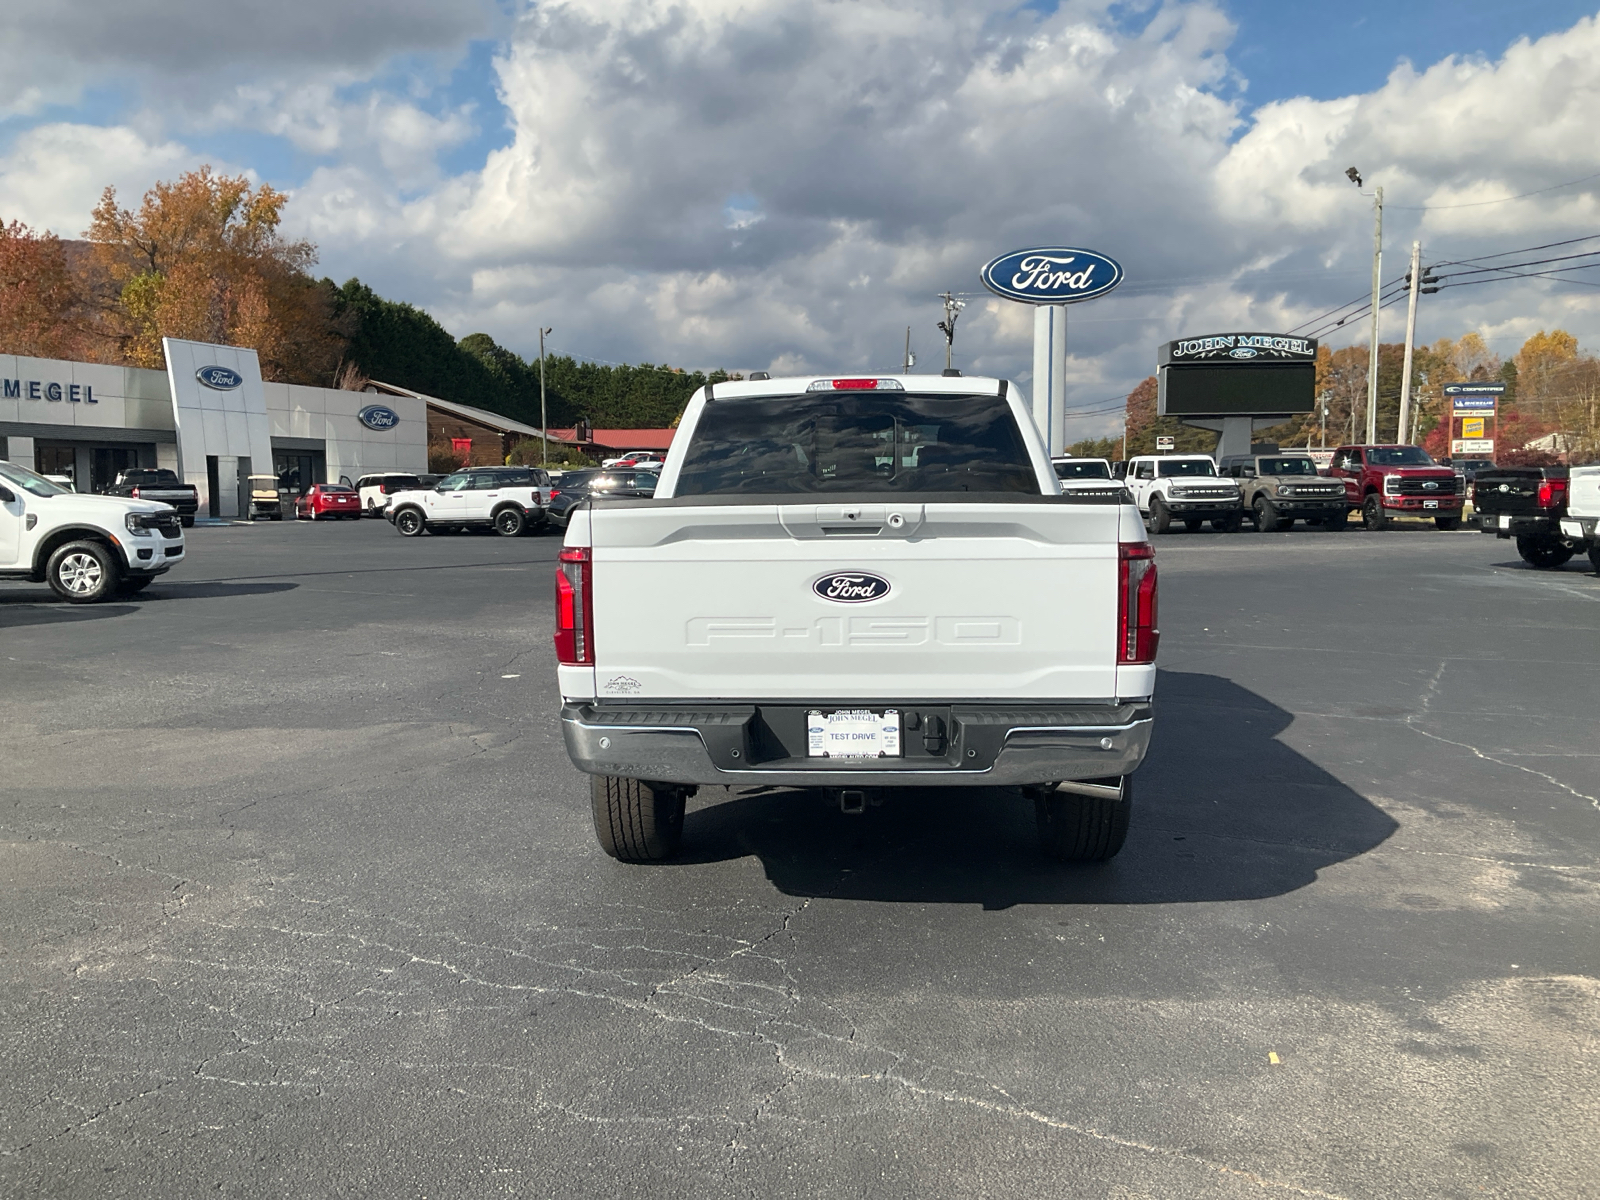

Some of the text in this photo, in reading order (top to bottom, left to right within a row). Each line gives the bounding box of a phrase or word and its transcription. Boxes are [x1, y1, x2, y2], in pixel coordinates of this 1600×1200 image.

[1012, 255, 1096, 290] Ford
[1173, 335, 1314, 357] JOHN MEGEL
[210, 370, 235, 386] Ford
[3, 378, 99, 404] MEGEL
[371, 410, 394, 426] Ford
[827, 576, 876, 597] Ford
[685, 616, 1022, 646] F-150
[829, 714, 849, 724] JOHN
